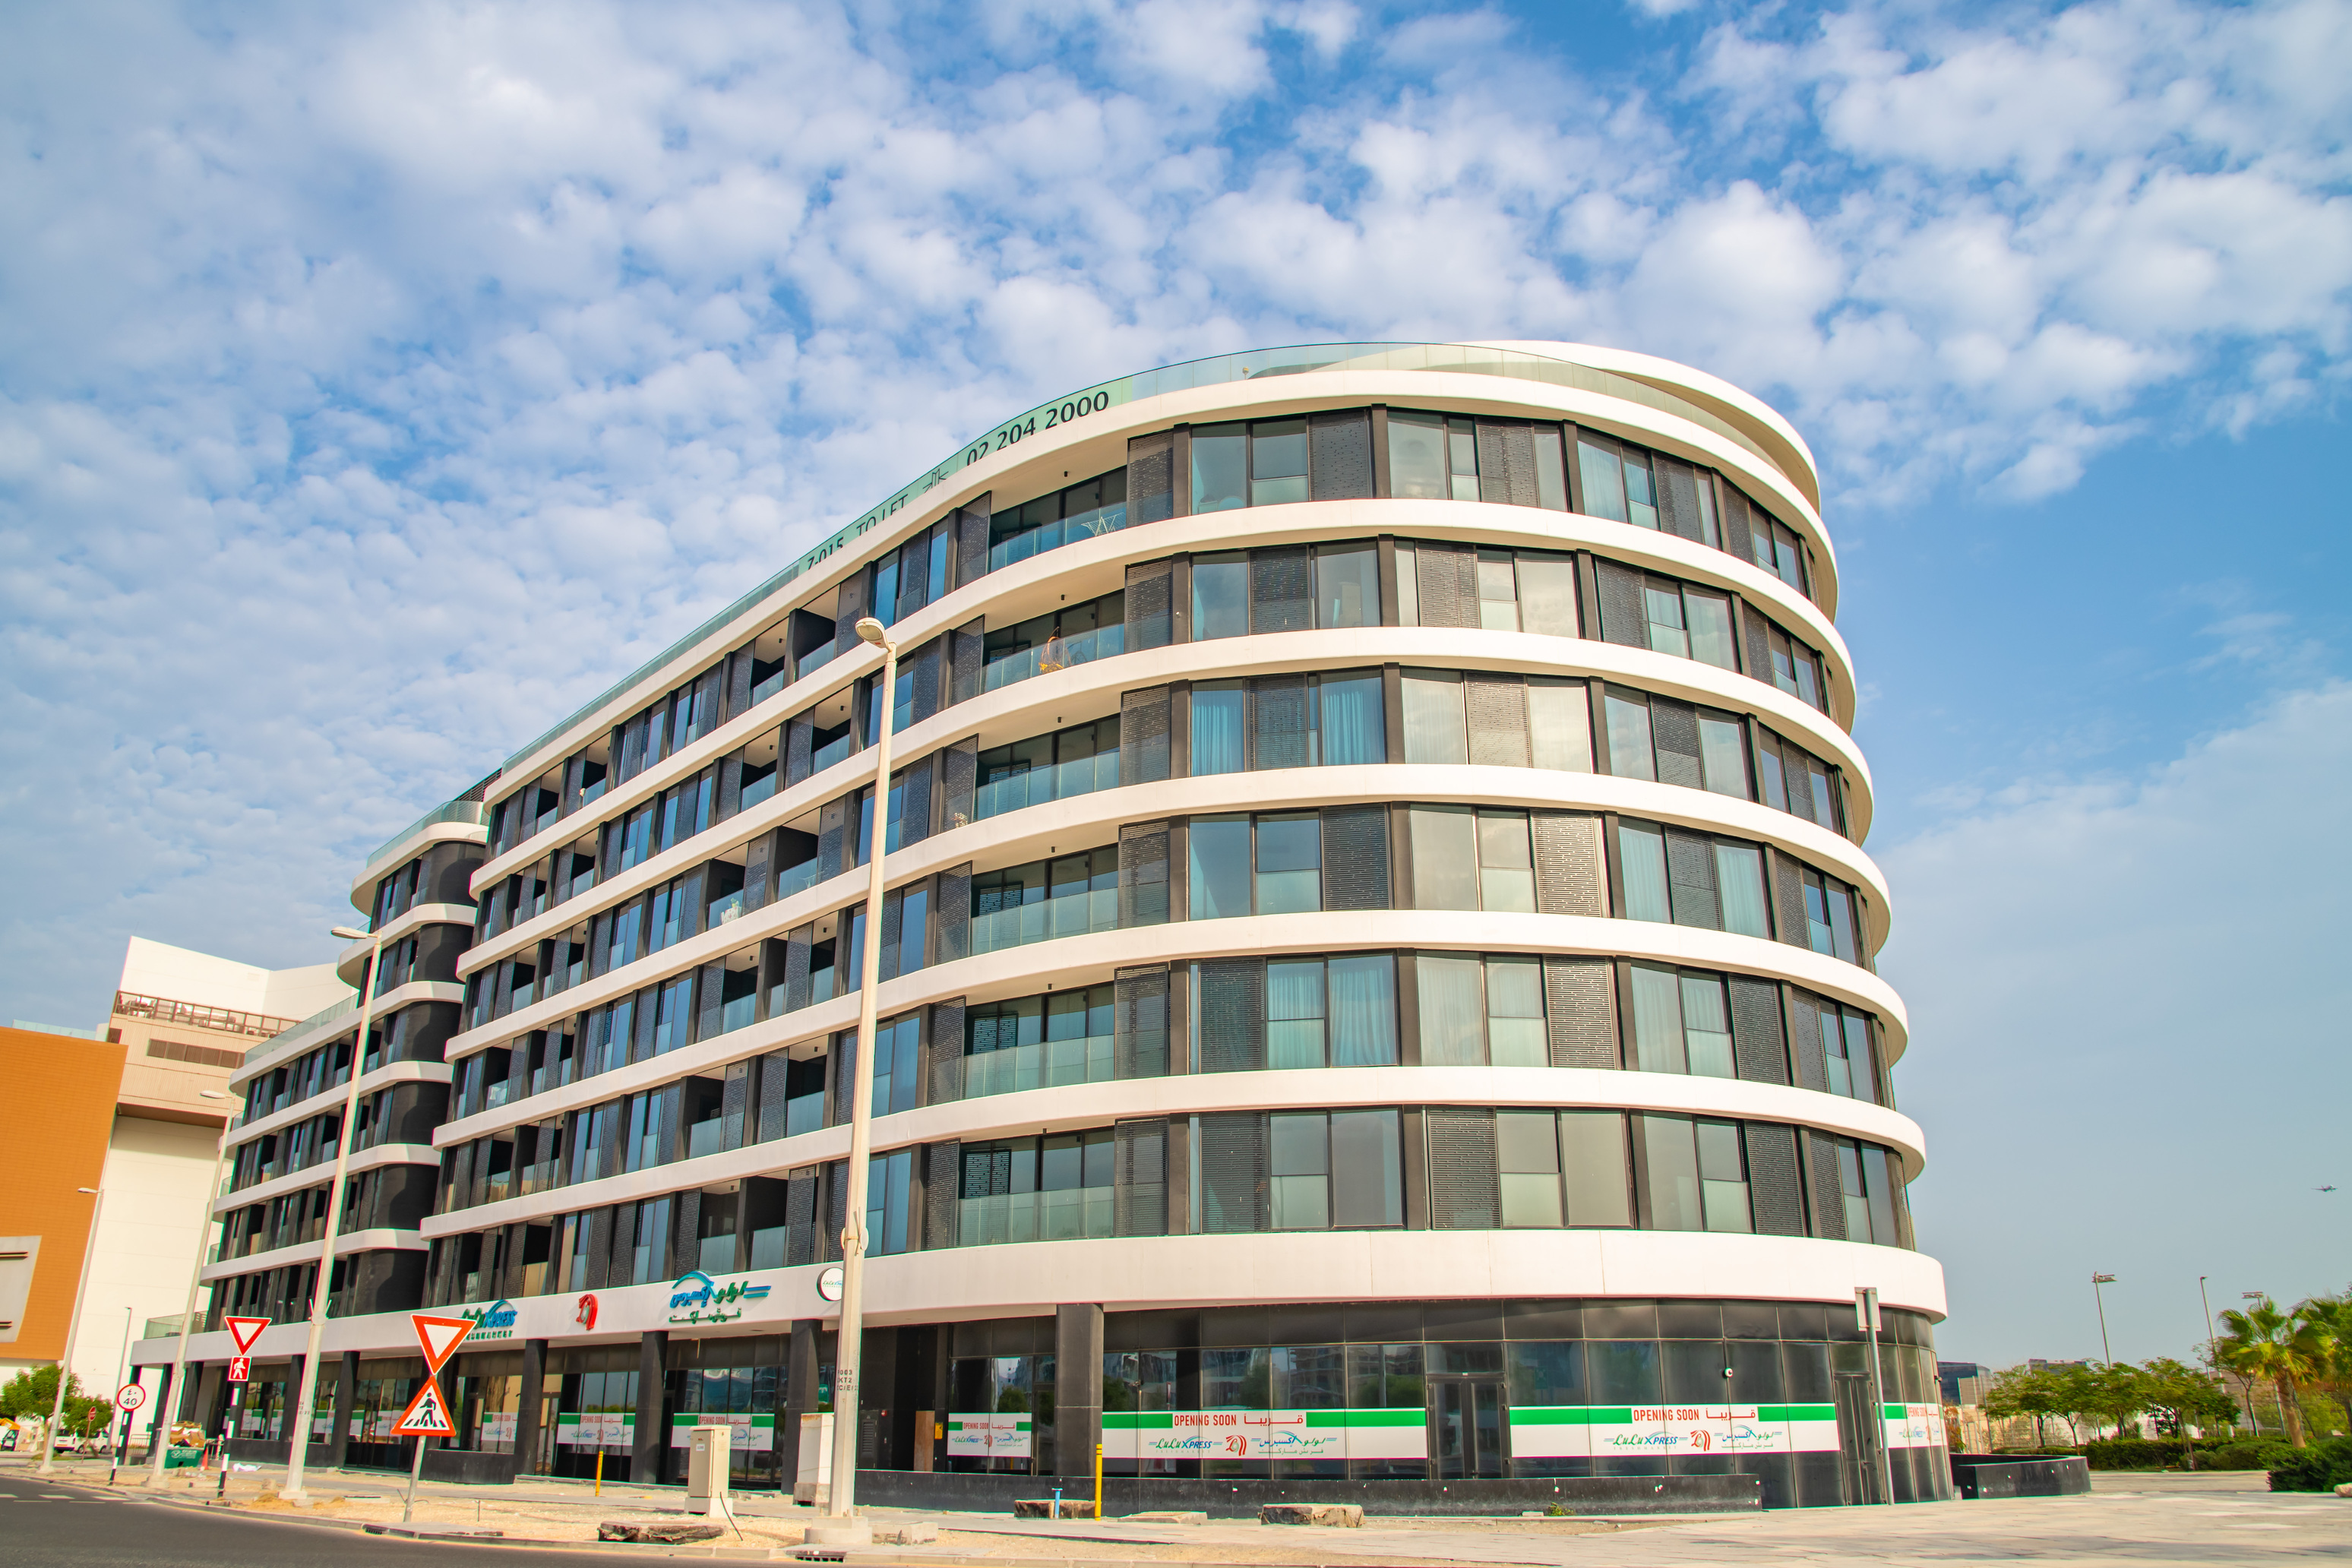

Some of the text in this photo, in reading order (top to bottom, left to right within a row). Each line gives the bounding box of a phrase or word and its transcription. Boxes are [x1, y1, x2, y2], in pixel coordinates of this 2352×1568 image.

[966, 441, 989, 466] 02
[996, 416, 1035, 451] 204
[1045, 391, 1109, 430] 2000
[123, 1398, 138, 1406] 40
[1174, 1414, 1237, 1427] OPENING SOON
[1633, 1408, 1699, 1421] OPENING SOON
